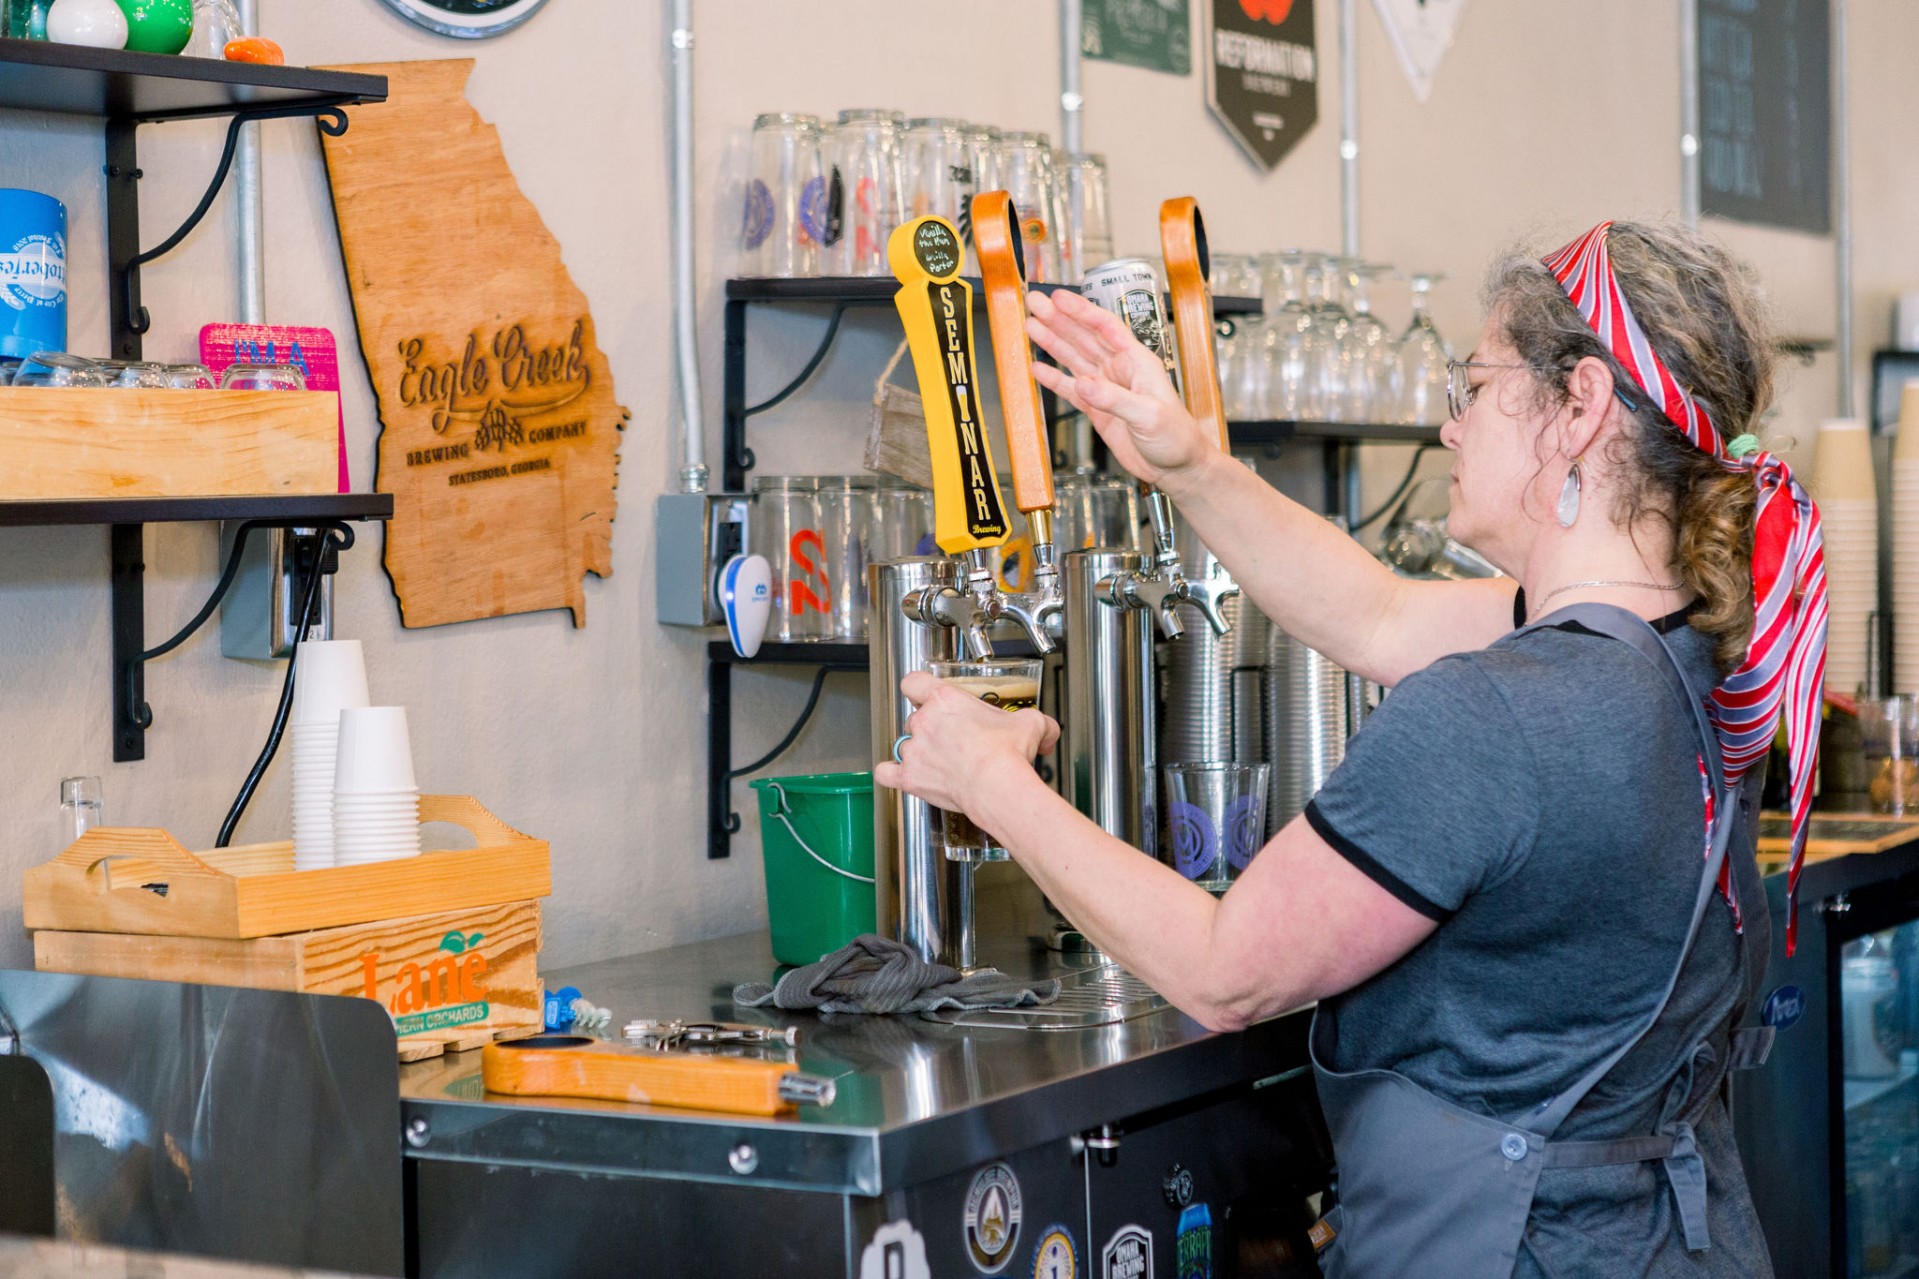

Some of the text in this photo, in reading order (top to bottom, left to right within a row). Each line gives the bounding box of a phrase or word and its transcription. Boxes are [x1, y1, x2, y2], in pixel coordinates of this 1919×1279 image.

[930, 260, 954, 273] Porter
[1101, 275, 1129, 287] SMALL
[289, 341, 310, 377] A
[398, 318, 590, 435] Eagle Creek
[940, 286, 991, 521] SEMINAR
[406, 420, 587, 467] BREWING COMPANY
[511, 458, 551, 475] GEORGIA
[972, 523, 1001, 535] Brewing
[357, 952, 489, 1017] Lane
[426, 1004, 484, 1029] ORCHARDS
